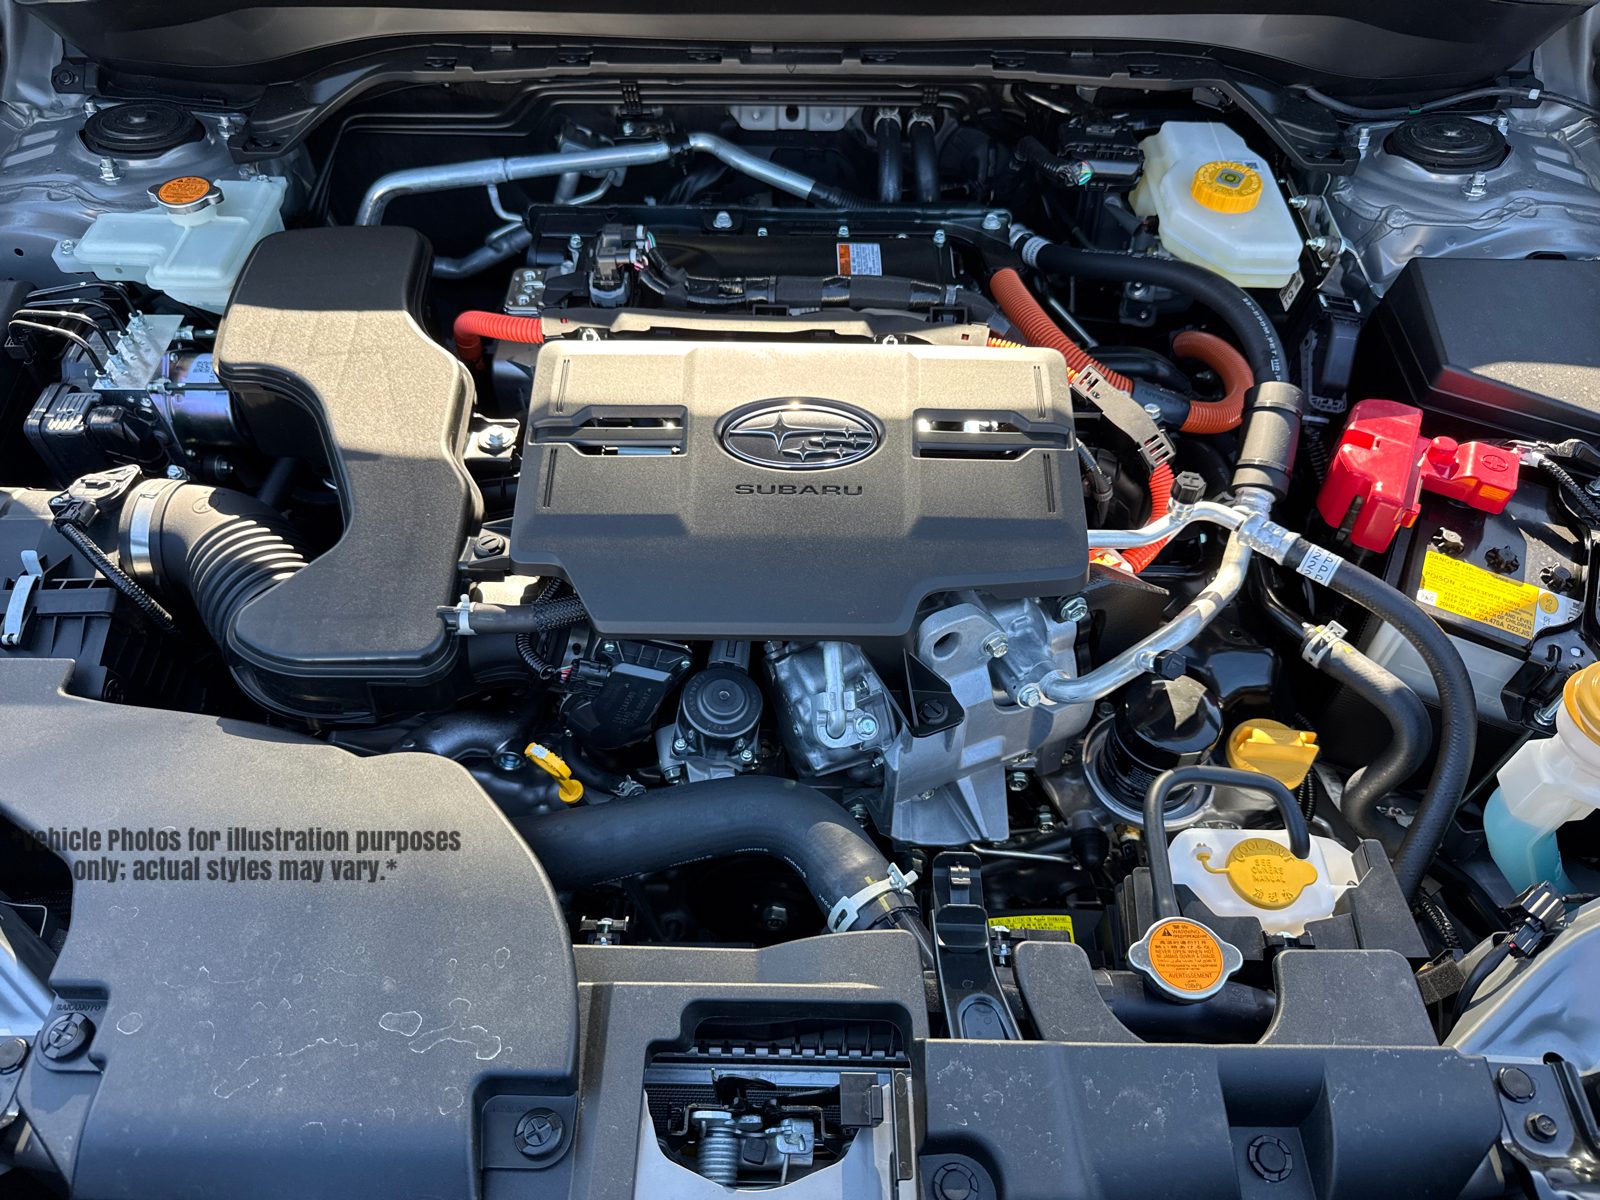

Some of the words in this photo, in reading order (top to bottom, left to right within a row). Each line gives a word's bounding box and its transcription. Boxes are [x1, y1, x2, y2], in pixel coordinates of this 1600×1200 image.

[1284, 290, 1294, 306] TQ
[735, 484, 862, 496] SUBARU
[1307, 560, 1316, 570] 2
[1318, 564, 1328, 573] P
[1428, 552, 1460, 567] DANGER
[1424, 571, 1455, 585] POISON
[1458, 583, 1480, 593] CAUSES
[1480, 590, 1501, 600] SEVERE
[1501, 597, 1520, 607] BURNS
[1438, 600, 1455, 609] 20HR
[1455, 606, 1472, 615] 62Ah
[1473, 612, 1489, 622] CCA
[1488, 617, 1504, 627] 470A
[1477, 607, 1496, 617] REACH
[1504, 617, 1532, 630] CHILDREN
[1488, 606, 1504, 615] TIGHT
[1516, 616, 1533, 625] LEVEL
[1233, 840, 1295, 862] COOLANT
[1254, 858, 1271, 866] SEE
[1251, 866, 1284, 875] OWNERS
[1252, 874, 1286, 884] MANUAL
